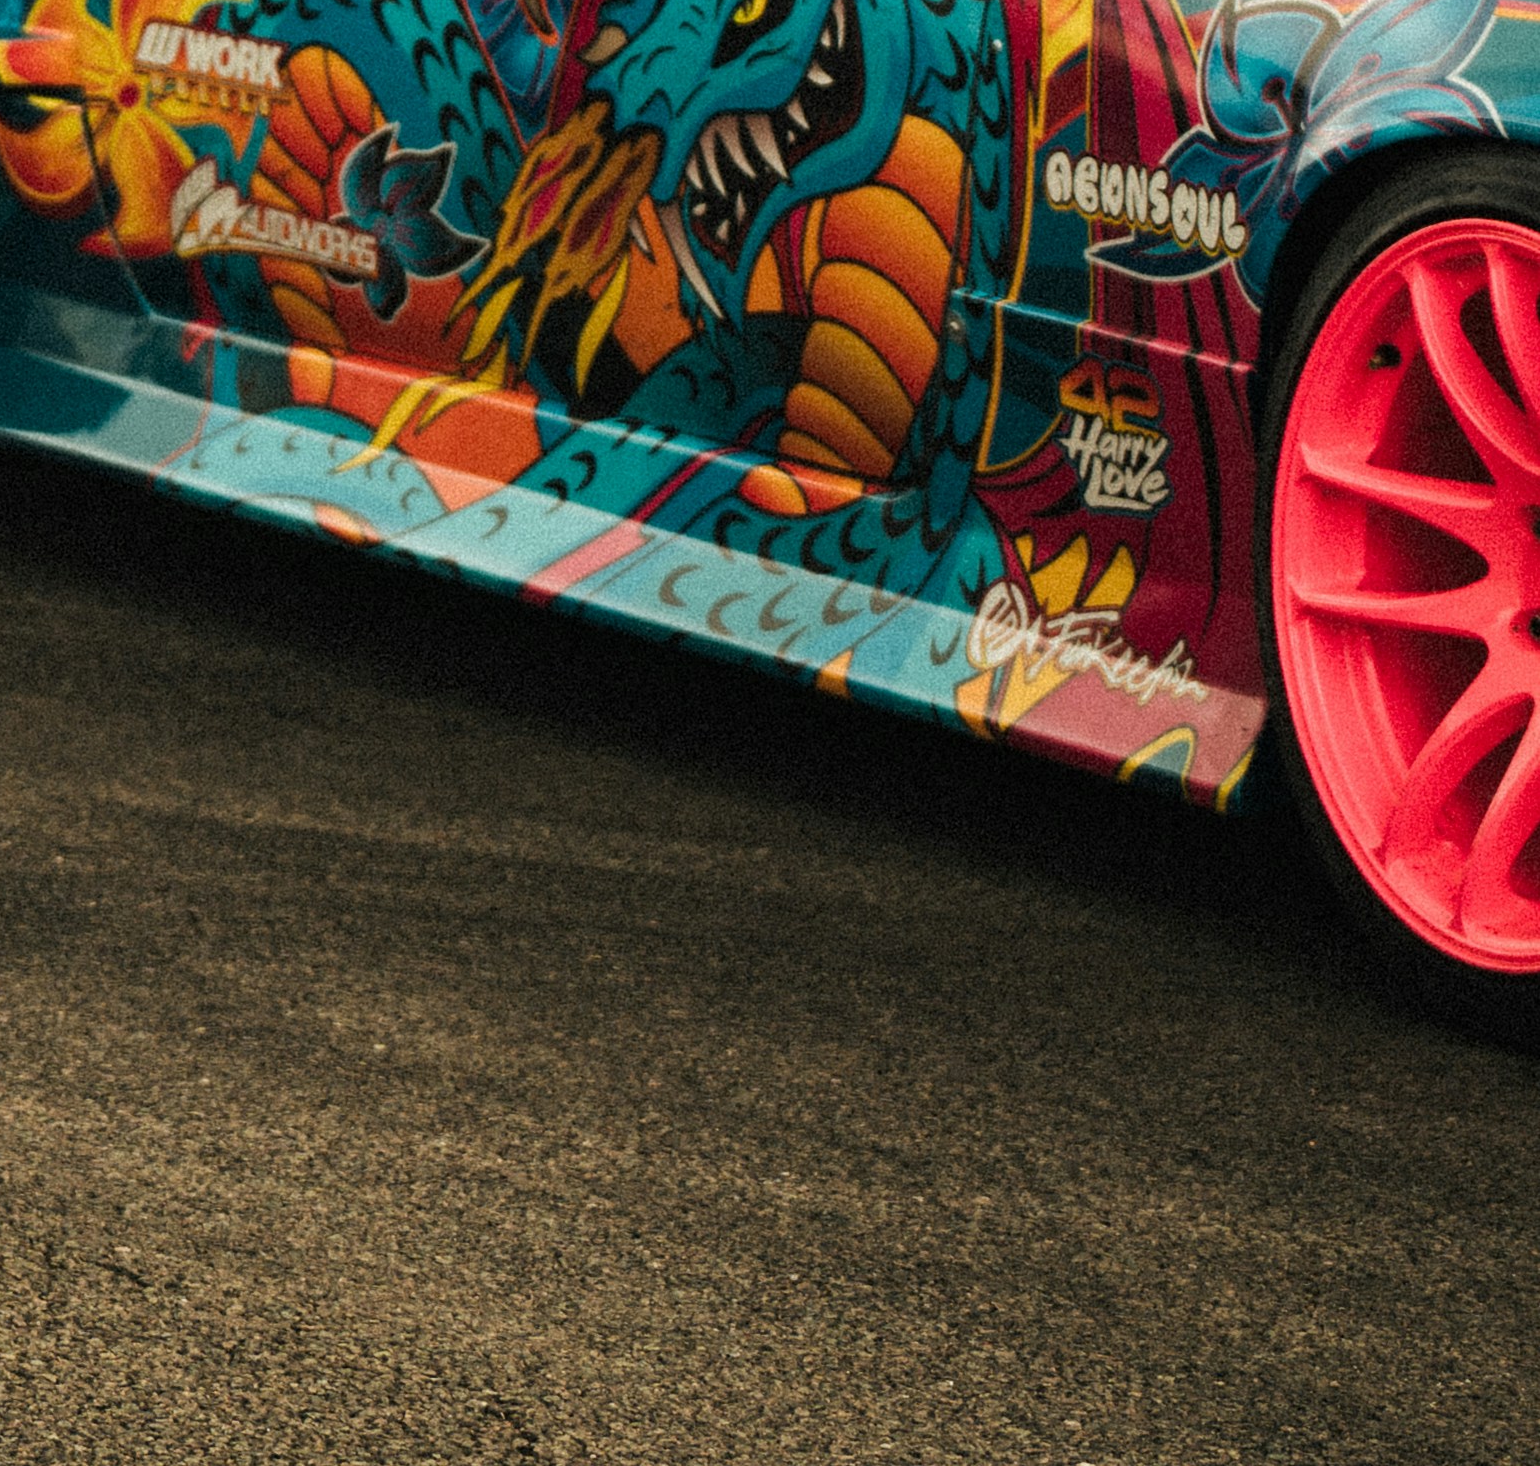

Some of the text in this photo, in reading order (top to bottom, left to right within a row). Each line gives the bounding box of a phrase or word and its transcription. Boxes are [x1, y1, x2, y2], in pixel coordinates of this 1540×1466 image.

[185, 28, 284, 90] WORK
[1058, 357, 1161, 438] 42
[1058, 413, 1169, 478] Harry
[1083, 454, 1170, 510] Love
